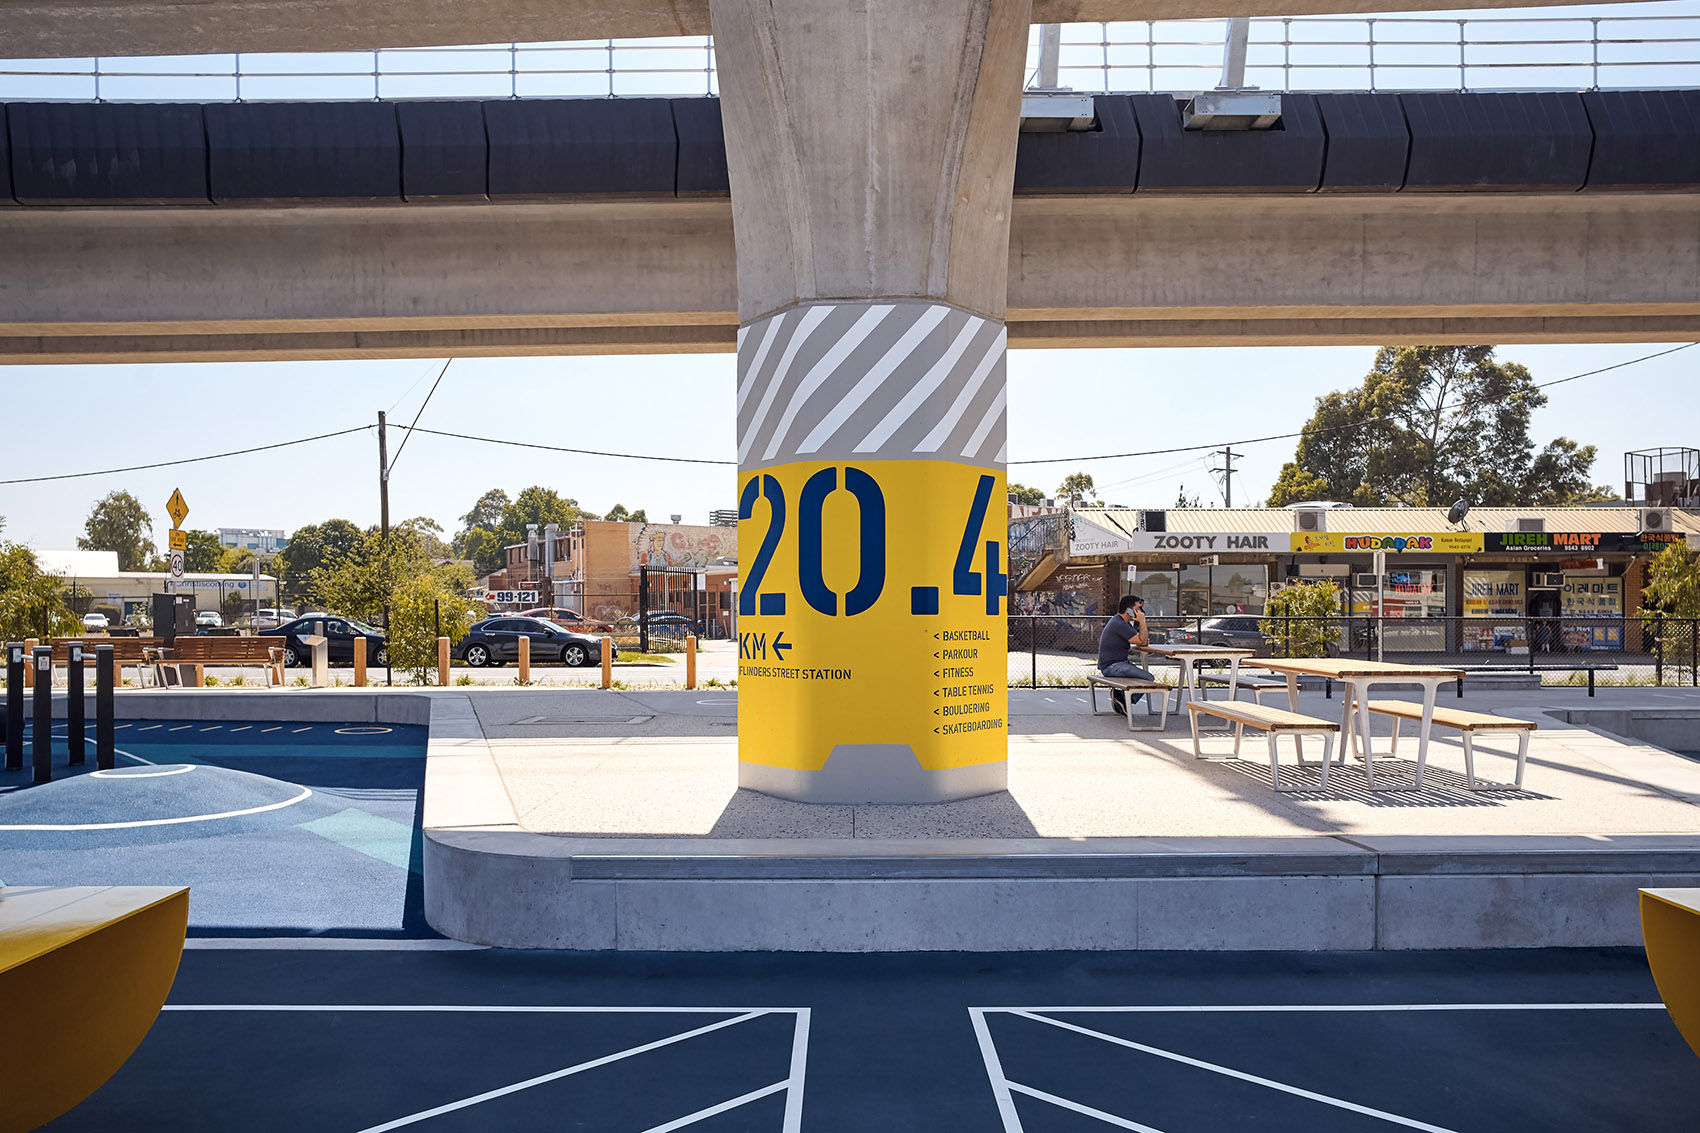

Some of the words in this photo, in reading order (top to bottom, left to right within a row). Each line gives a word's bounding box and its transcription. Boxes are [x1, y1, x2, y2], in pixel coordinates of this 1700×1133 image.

[1075, 542, 1100, 551] ZOOTY
[1101, 540, 1119, 549] HAIR
[1154, 536, 1217, 549] ZOOTY
[1227, 536, 1269, 549] HAIR
[1344, 536, 1433, 550] HUDADAK
[1499, 533, 1548, 546] JIREH
[1553, 533, 1602, 545] MART
[173, 560, 182, 572] 40
[1496, 583, 1519, 596] MART
[1563, 583, 1619, 594] 이레마트
[497, 591, 535, 602] 99-121
[943, 630, 990, 641] BASKETBALL
[739, 632, 767, 661] KM
[943, 648, 978, 660] PARKOUR
[739, 665, 771, 677] FLINDERS
[772, 667, 800, 679] STREET
[802, 669, 852, 680] STATION
[943, 667, 974, 678] FITNESS
[943, 686, 967, 698] TABLE
[968, 684, 994, 695] TENNIS
[943, 702, 990, 716] BOULDERING
[943, 718, 1003, 735] SKATEBOARDING
